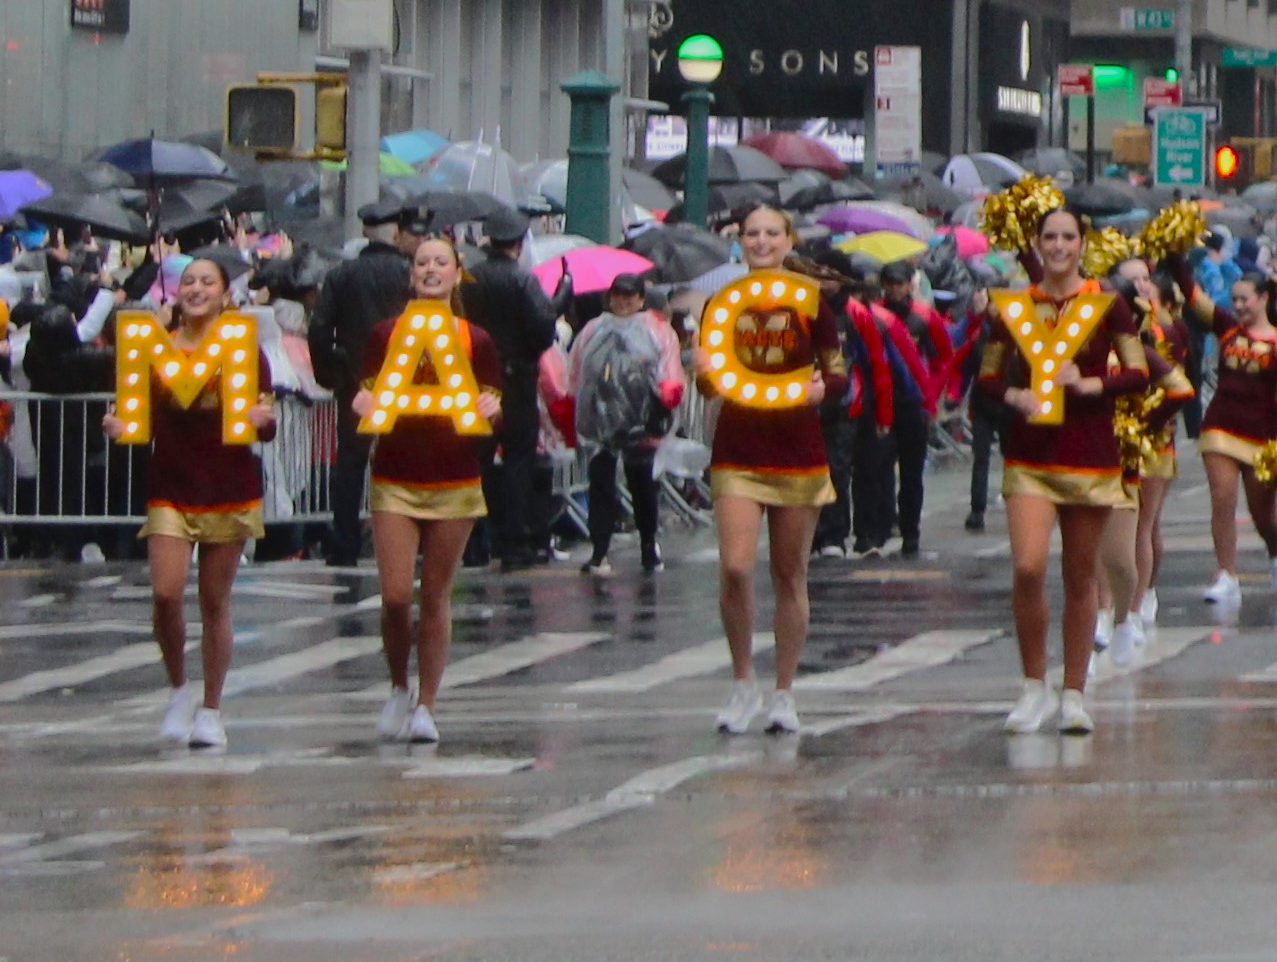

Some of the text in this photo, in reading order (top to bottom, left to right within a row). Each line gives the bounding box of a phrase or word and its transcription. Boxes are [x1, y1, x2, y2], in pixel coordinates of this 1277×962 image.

[749, 49, 869, 76] SONS
[1160, 138, 1200, 150] Hudson
[1166, 150, 1193, 163] River
[116, 310, 259, 444] M
[357, 301, 492, 436] A
[700, 269, 820, 410] C
[988, 289, 1116, 425] Y
